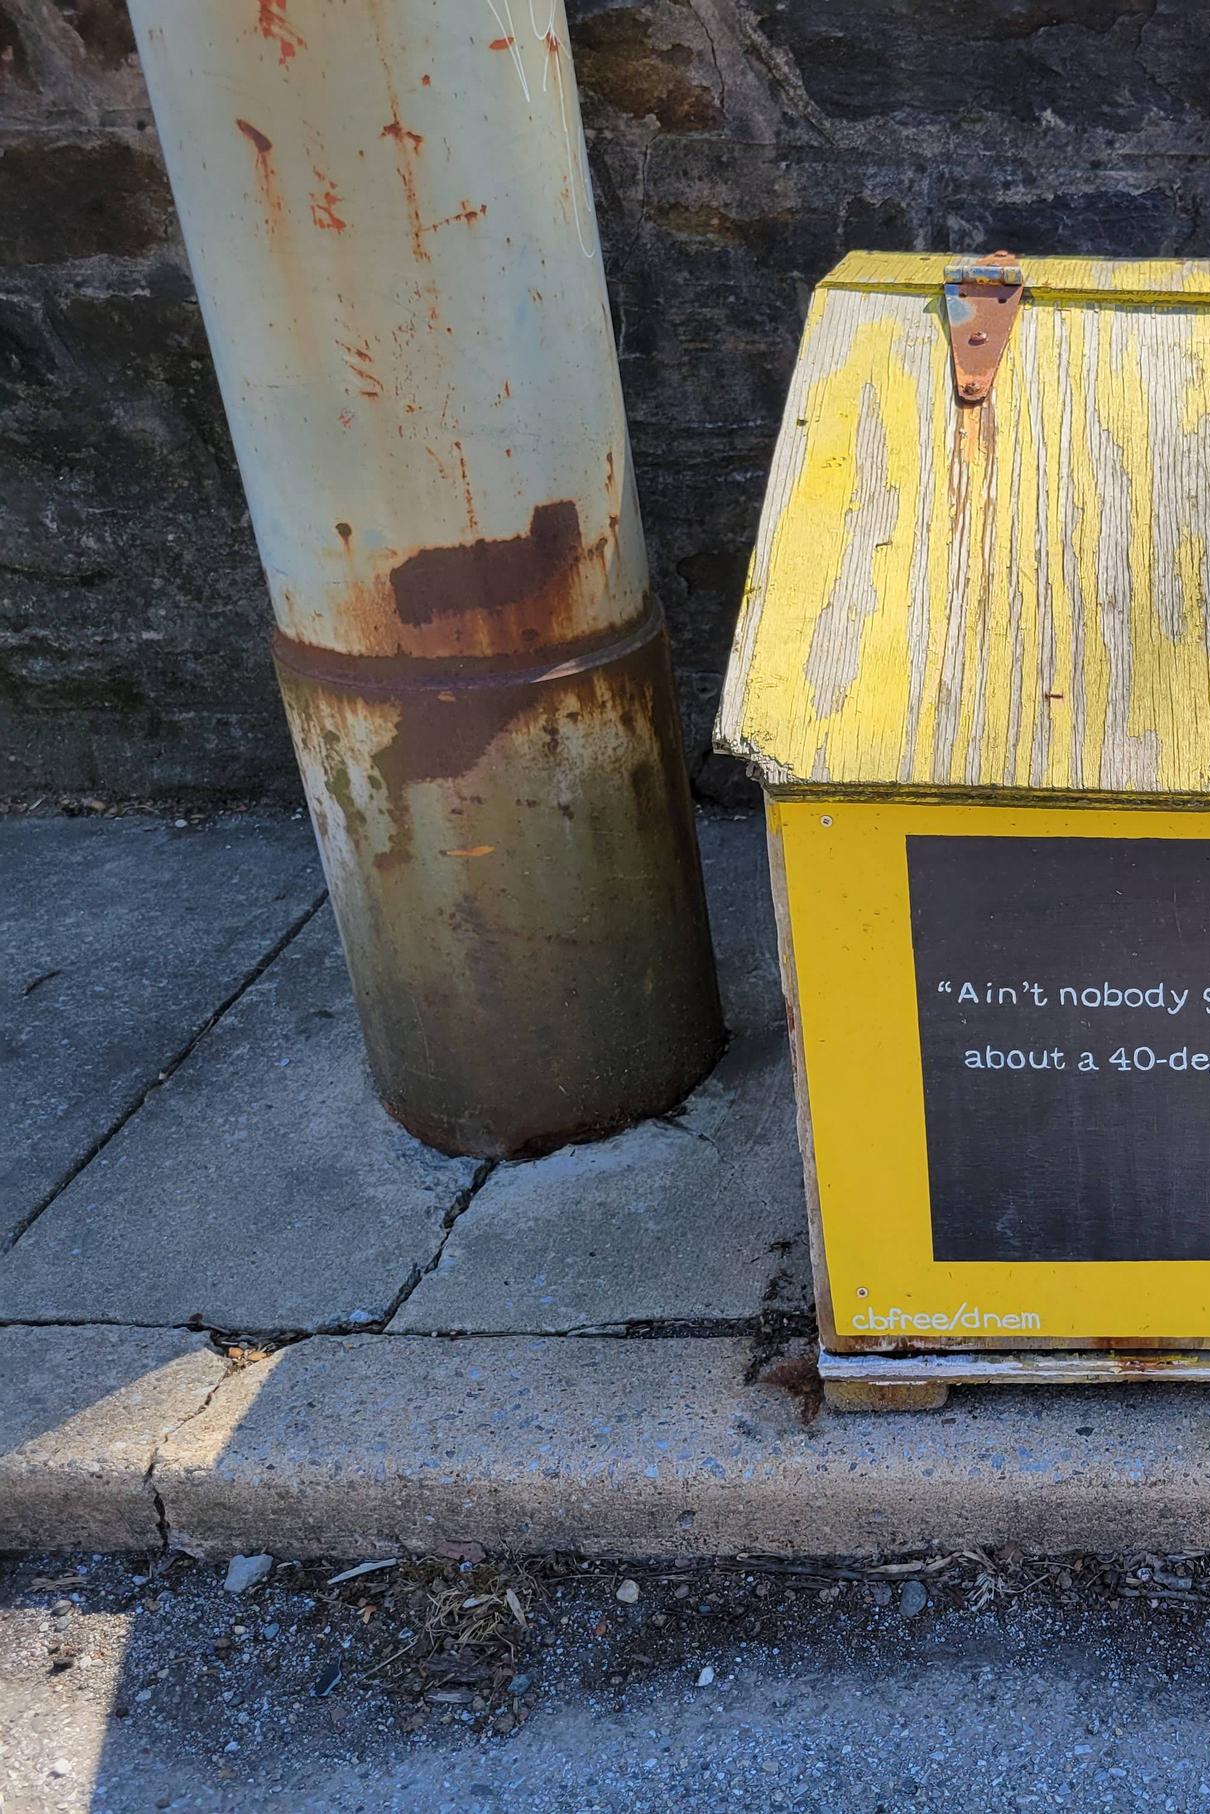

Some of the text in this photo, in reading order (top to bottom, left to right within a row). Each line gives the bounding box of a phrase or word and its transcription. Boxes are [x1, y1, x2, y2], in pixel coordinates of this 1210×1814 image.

[937, 981, 1048, 1007] “Ain’t
[1059, 981, 1189, 1015] nobody
[964, 1045, 1066, 1070] about
[1077, 1051, 1099, 1072] a
[852, 1302, 1041, 1331] cbfree/dnem
